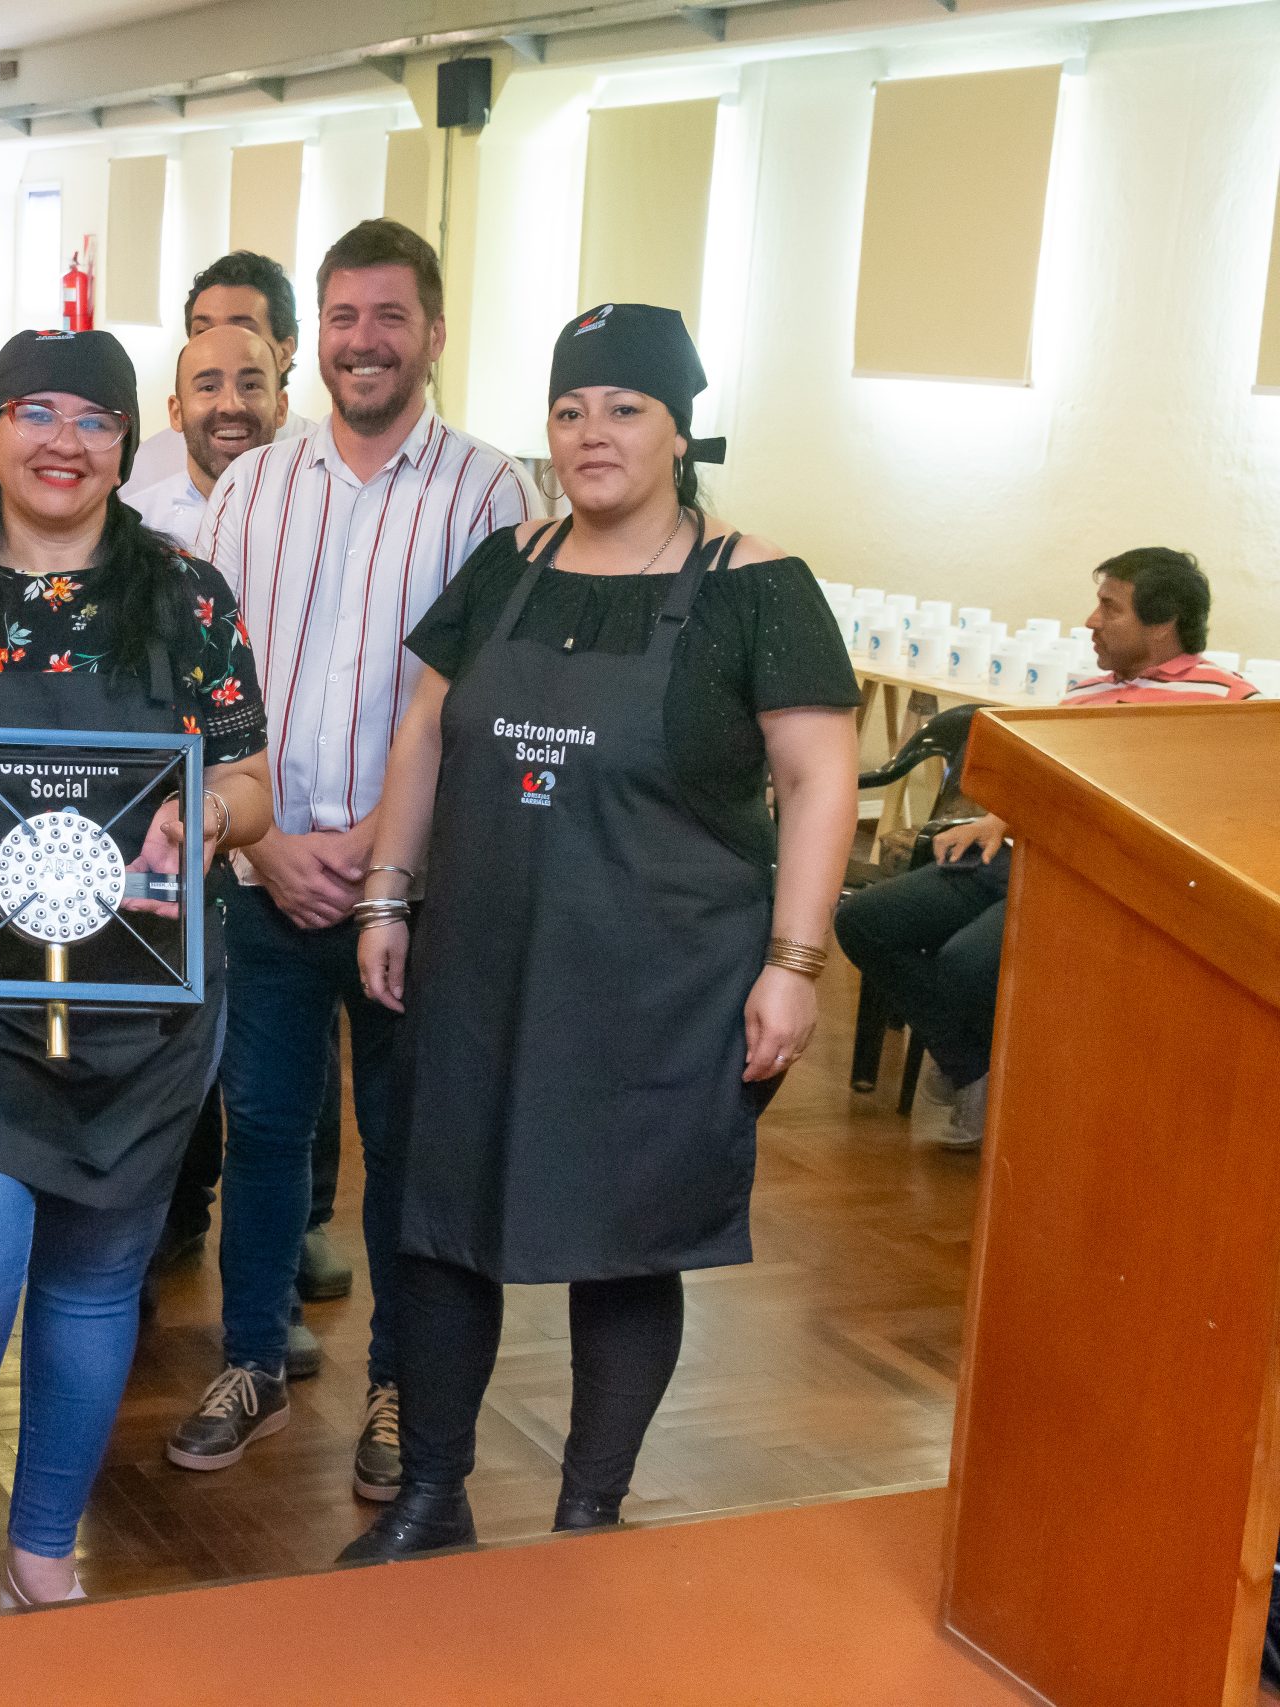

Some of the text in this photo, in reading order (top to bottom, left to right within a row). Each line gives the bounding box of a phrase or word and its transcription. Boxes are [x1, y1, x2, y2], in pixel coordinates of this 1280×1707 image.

[493, 717, 596, 746] Gastronomia
[515, 741, 566, 765] Social
[30, 778, 88, 799] Social
